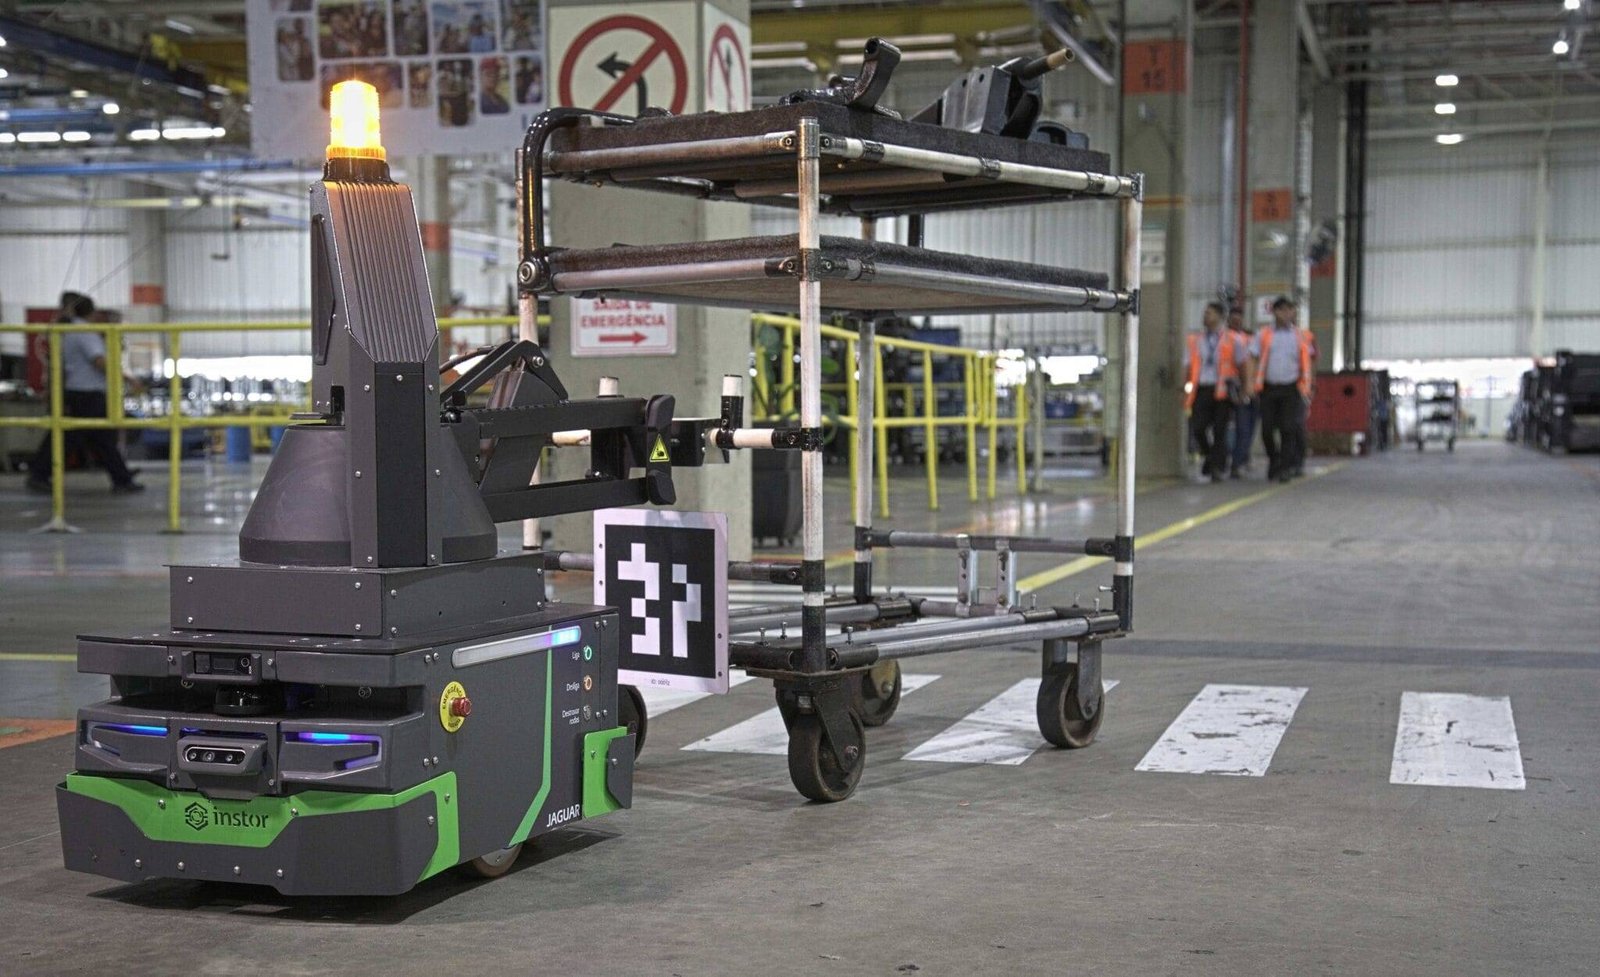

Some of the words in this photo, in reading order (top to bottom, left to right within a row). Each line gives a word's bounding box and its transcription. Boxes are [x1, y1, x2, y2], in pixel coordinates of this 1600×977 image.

[581, 314, 665, 328] EMERGÊNCIA
[213, 806, 268, 828] instor
[546, 804, 580, 828] JAGUAR
